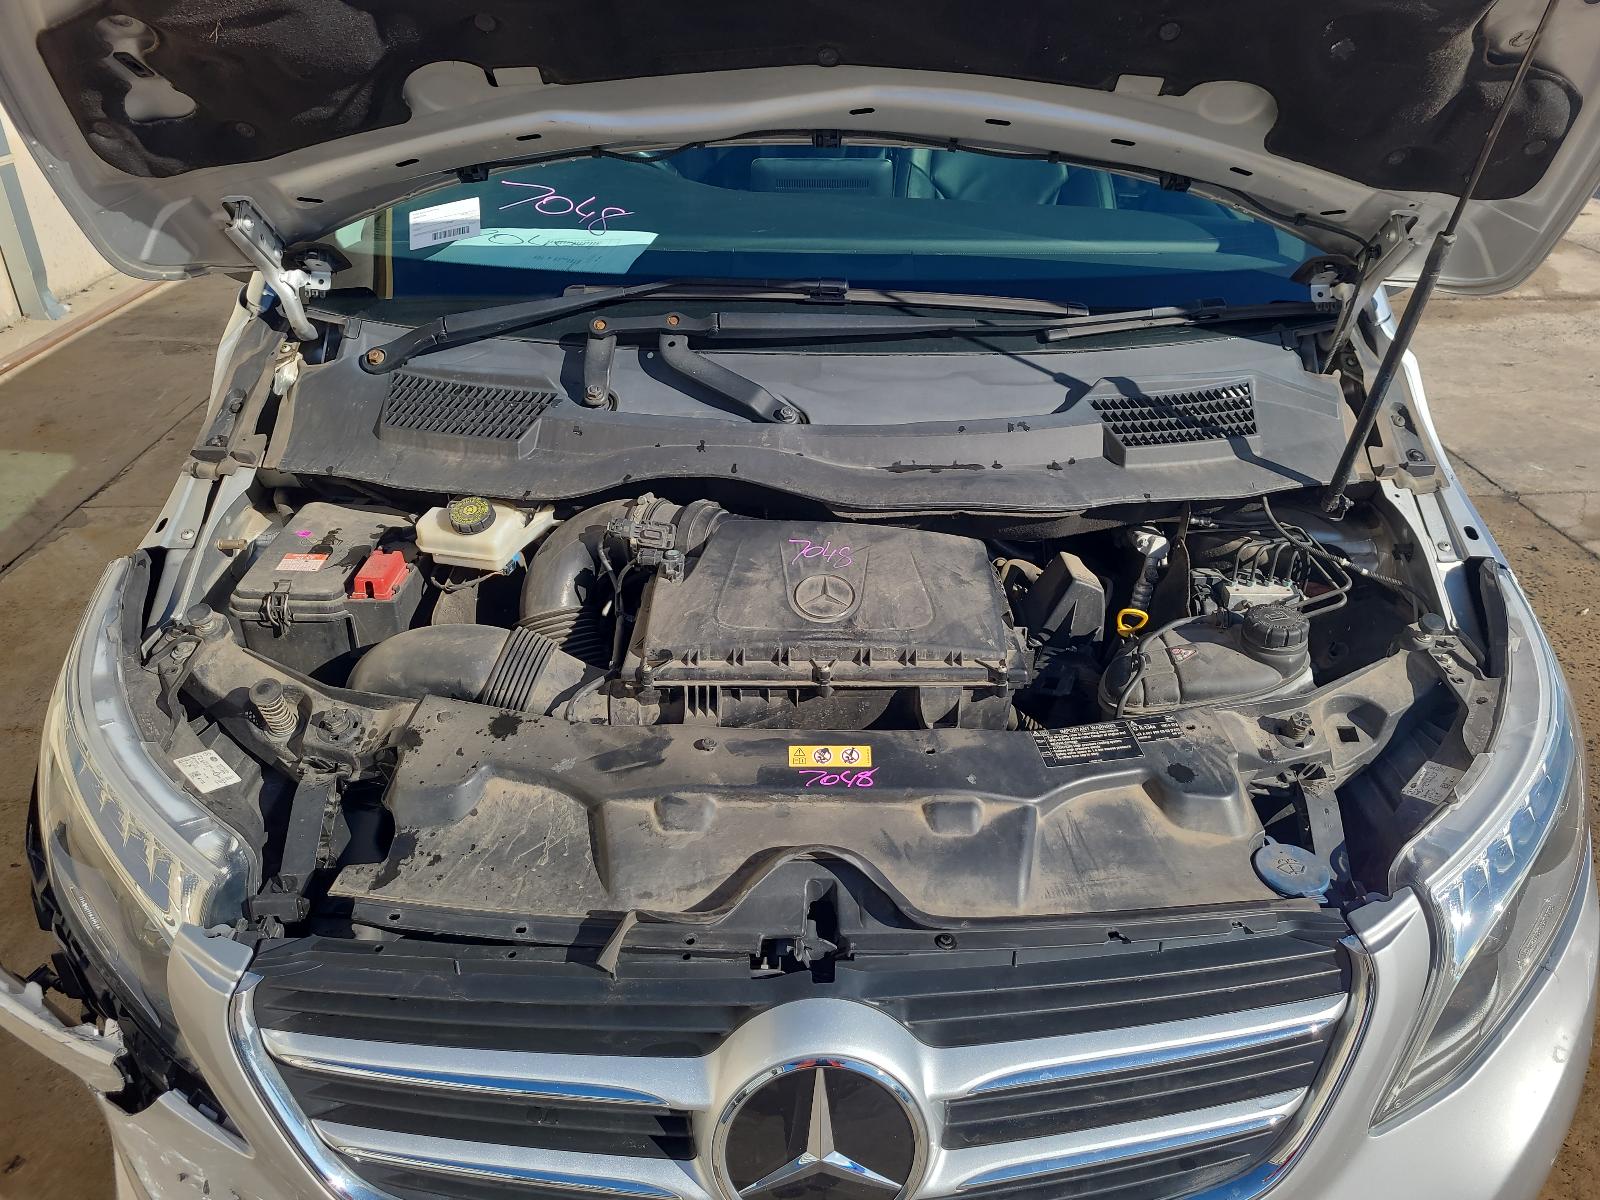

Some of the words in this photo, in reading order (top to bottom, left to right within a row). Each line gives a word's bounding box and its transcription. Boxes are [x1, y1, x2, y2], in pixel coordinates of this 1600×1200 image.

[499, 180, 635, 236] 7048
[789, 538, 852, 569] 7048
[799, 766, 880, 788] 7048
